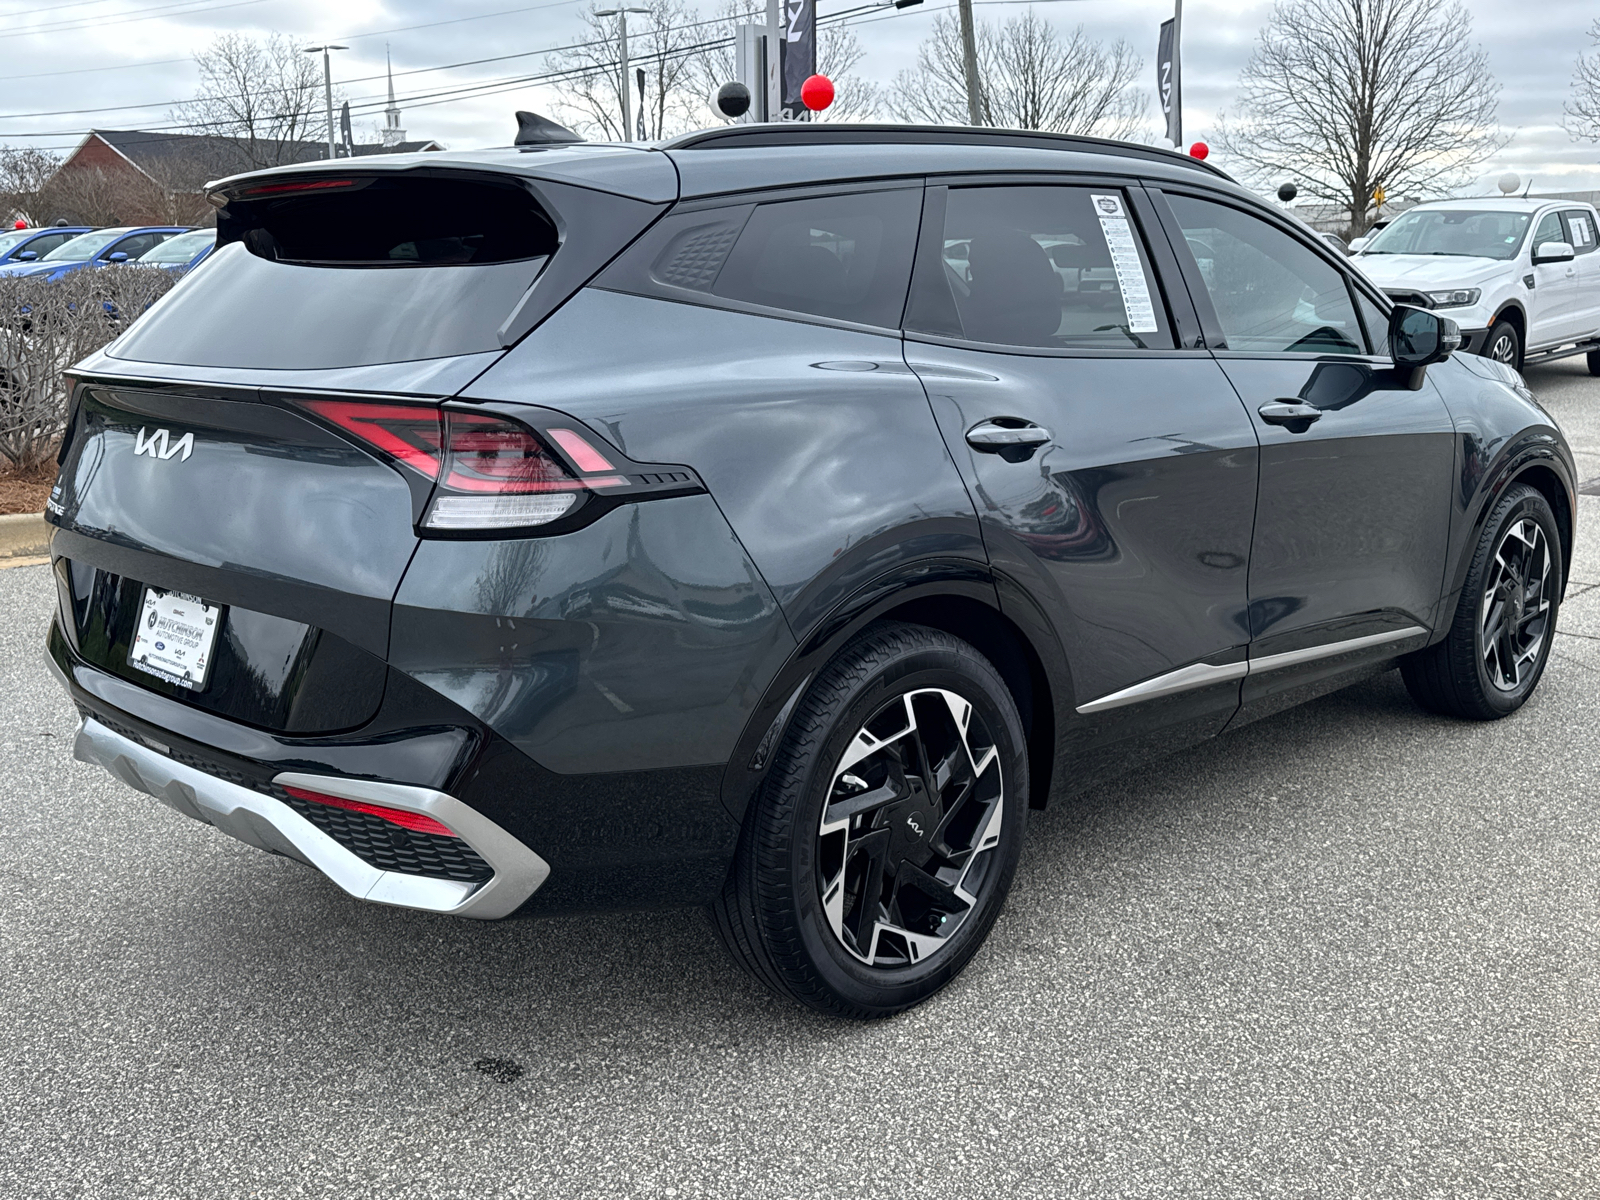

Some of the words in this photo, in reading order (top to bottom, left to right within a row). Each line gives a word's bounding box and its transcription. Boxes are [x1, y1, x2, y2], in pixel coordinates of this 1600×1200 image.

[134, 426, 194, 463] KIA
[156, 629, 183, 644] AUTOMOTIVE
[183, 638, 199, 649] GROUP
[157, 616, 204, 641] HUTCHINSON
[907, 818, 924, 837] KIA
